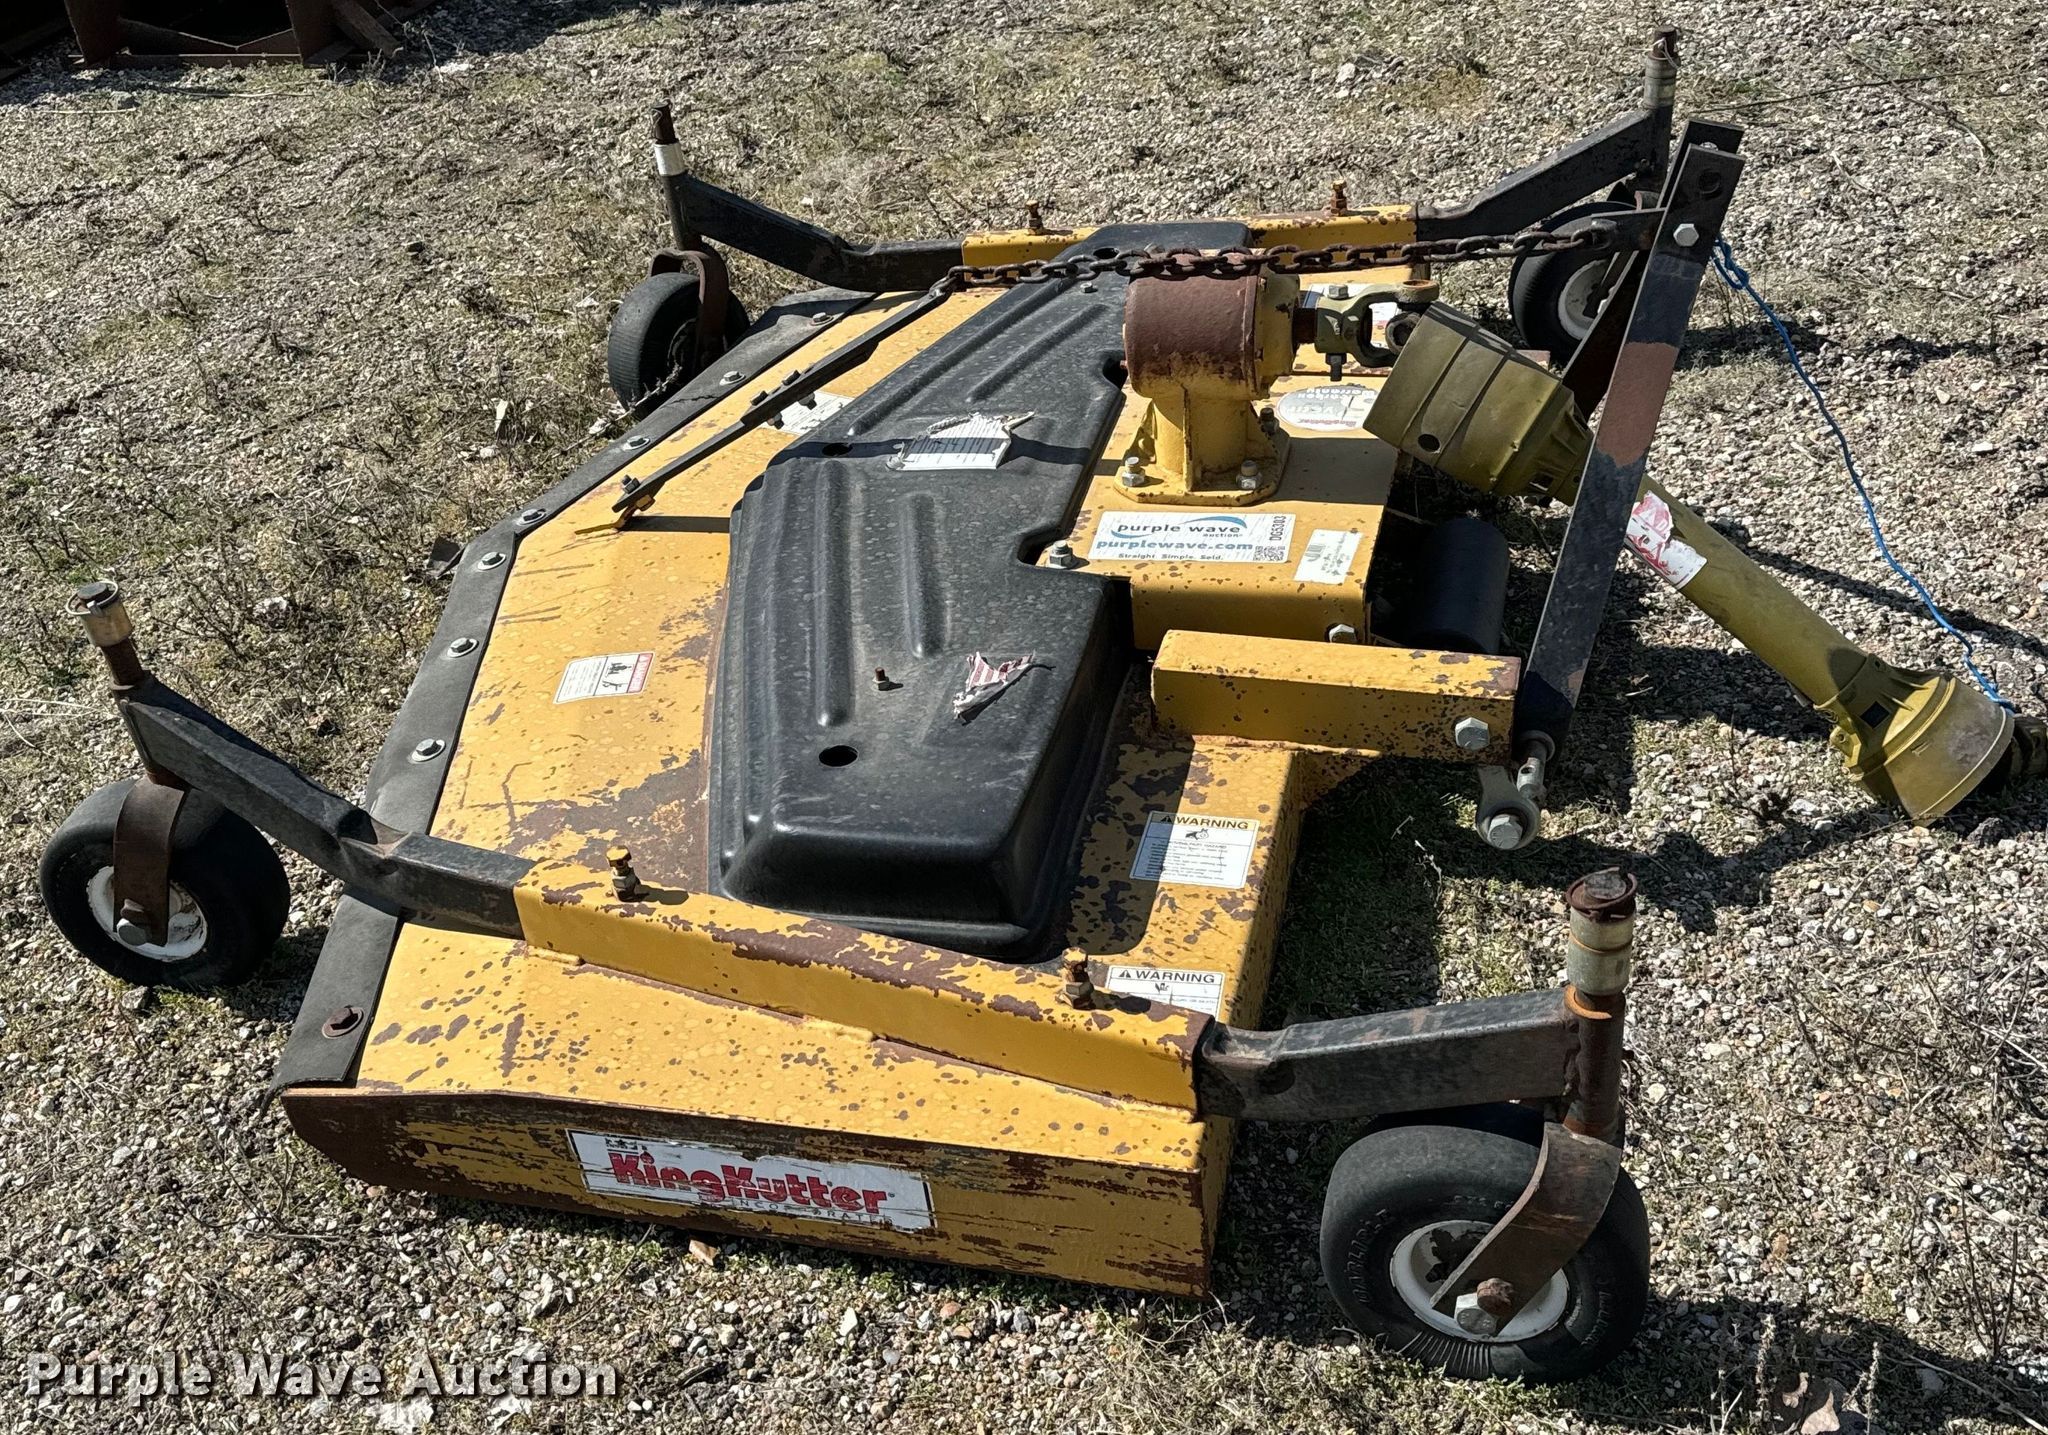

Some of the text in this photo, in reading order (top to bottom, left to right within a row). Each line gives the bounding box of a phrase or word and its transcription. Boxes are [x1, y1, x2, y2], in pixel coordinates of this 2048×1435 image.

[1117, 524, 1181, 533] purple
[1268, 515, 1287, 541] DG5303
[1096, 540, 1254, 550] purplewave.com
[1176, 816, 1249, 830] WARNING
[1135, 970, 1215, 984] WARNING
